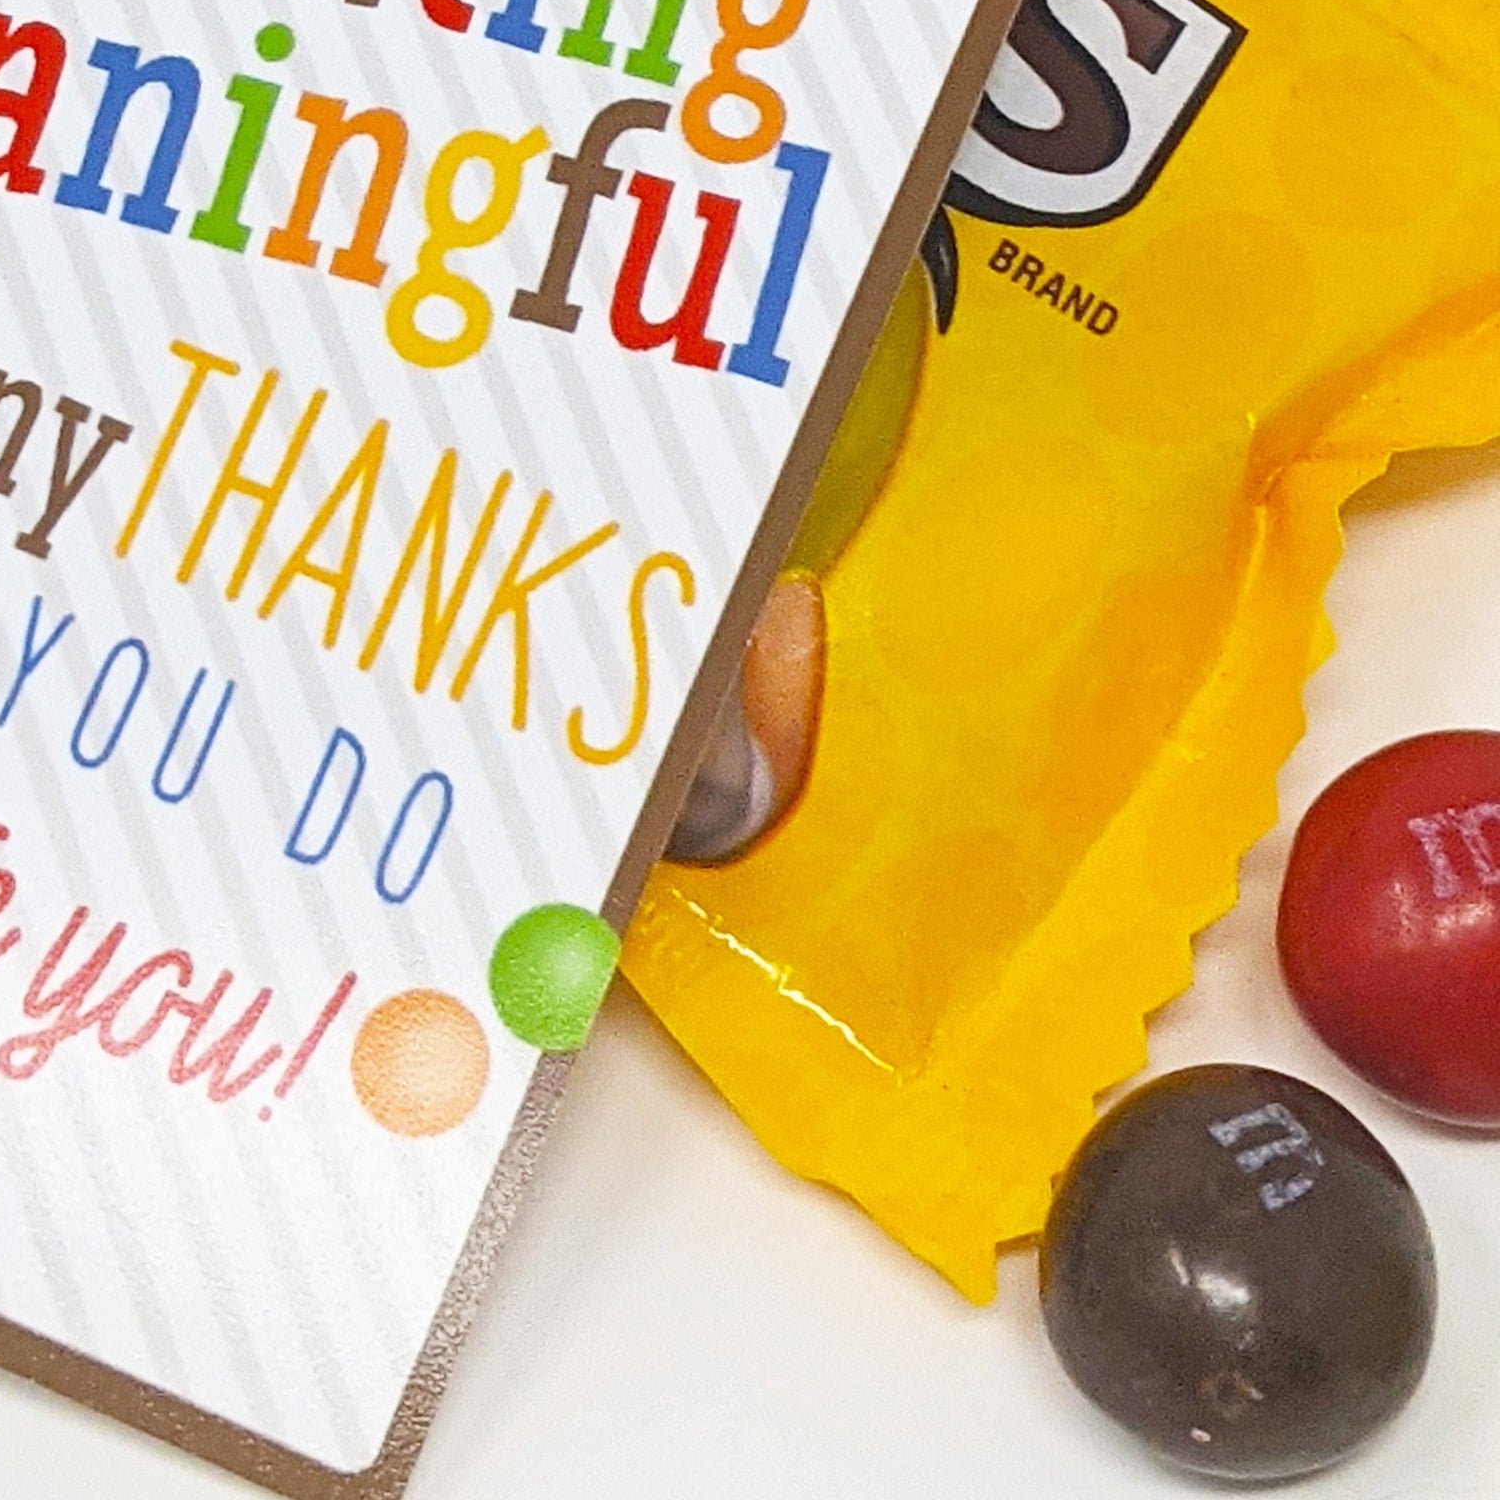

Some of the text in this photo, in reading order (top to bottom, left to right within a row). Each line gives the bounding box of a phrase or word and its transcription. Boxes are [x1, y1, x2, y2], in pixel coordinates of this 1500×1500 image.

[986, 237, 1122, 337] BRAND
[115, 338, 696, 766] THANKS
[284, 726, 455, 904] DO
